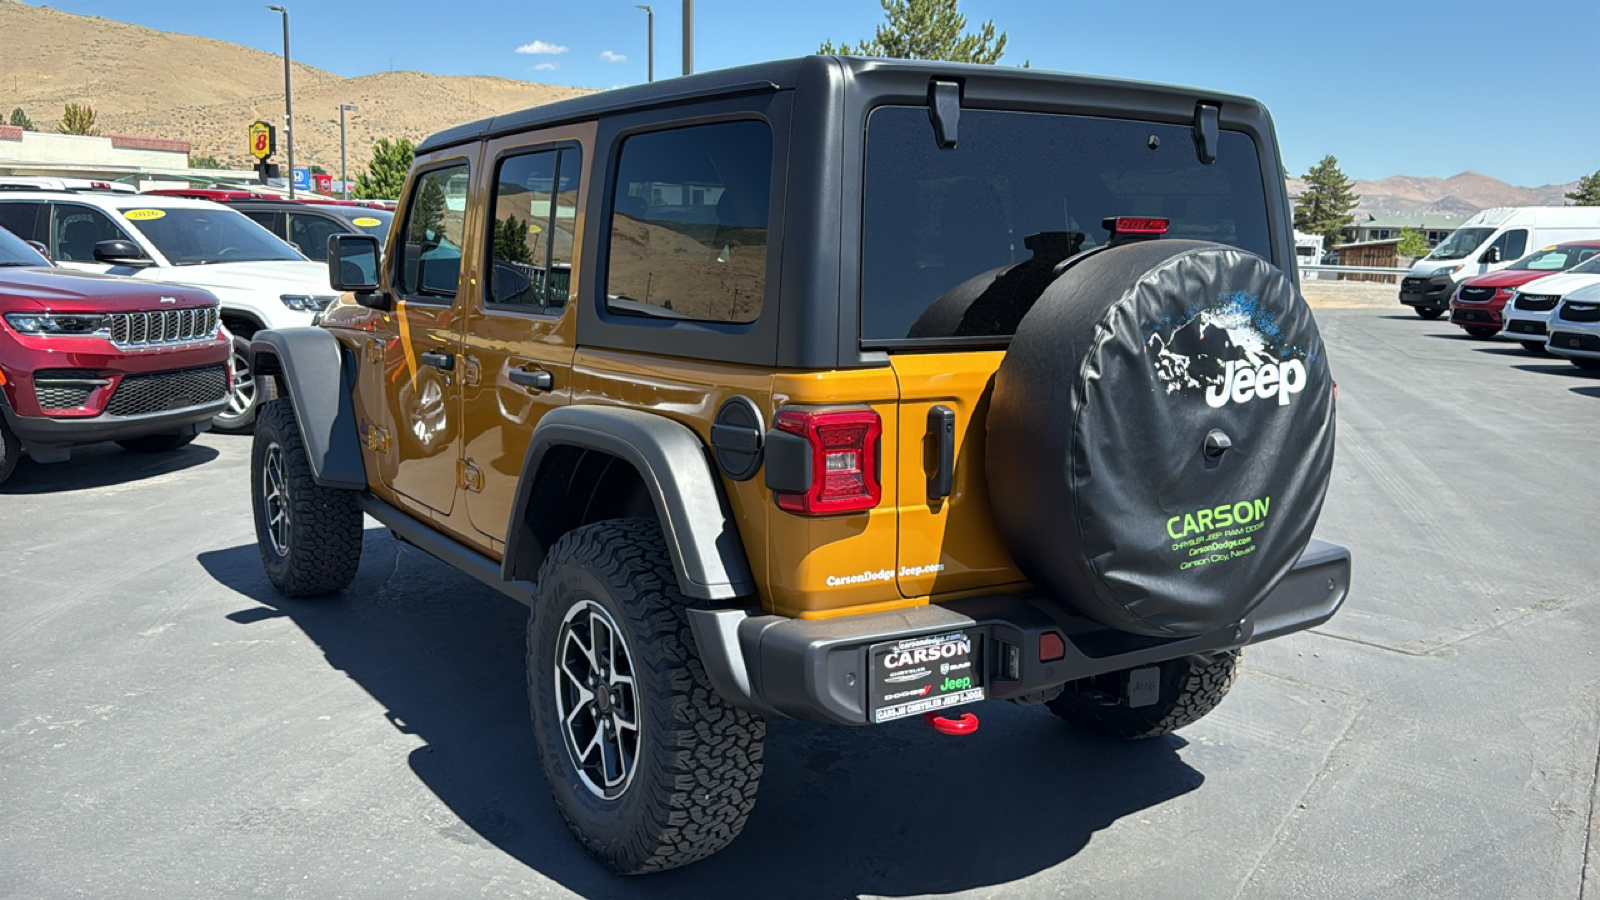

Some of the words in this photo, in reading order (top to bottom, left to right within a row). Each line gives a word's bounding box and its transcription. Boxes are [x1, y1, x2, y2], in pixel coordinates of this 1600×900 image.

[254, 133, 267, 151] 8
[1205, 358, 1307, 408] Jeep
[1166, 496, 1270, 540] CARSON
[1206, 531, 1223, 541] JEEP
[1224, 527, 1244, 537] RAM
[1245, 520, 1265, 533] DODGE
[1189, 536, 1252, 556] CarsonDodge.com
[1180, 556, 1210, 570] Carson
[1230, 544, 1256, 559] Nevada
[884, 639, 971, 669] CARSON
[889, 667, 926, 677] CHRYSLER
[949, 661, 971, 671] RAM
[940, 676, 970, 692] Jeep
[1133, 681, 1156, 692] Jeep
[884, 688, 925, 701] DODGE
[907, 699, 941, 712] CHRYSLER
[943, 695, 959, 705] JEEP
